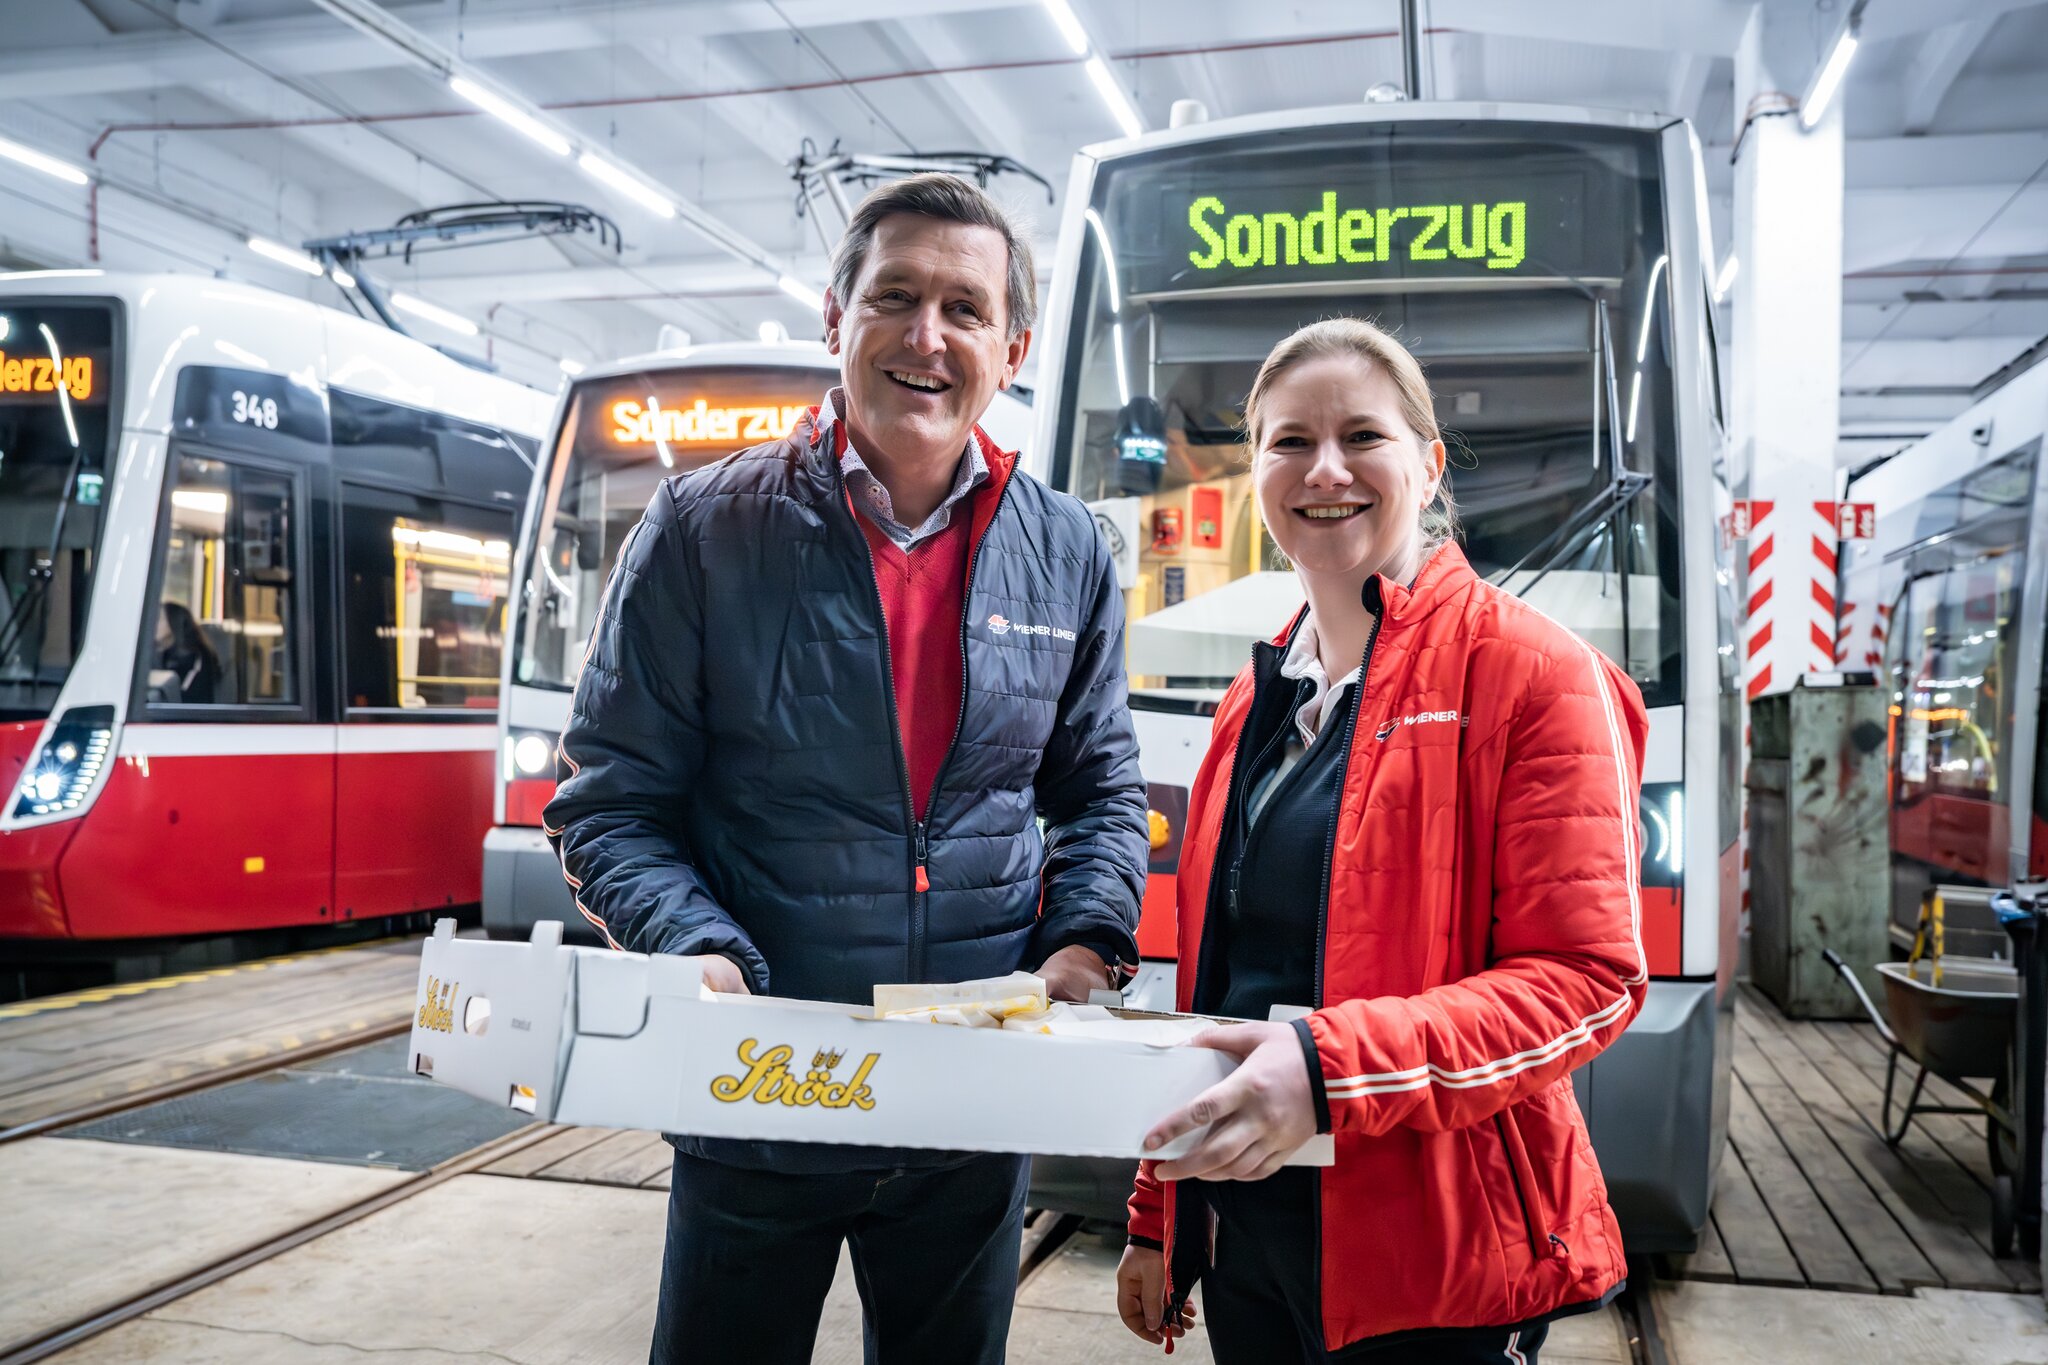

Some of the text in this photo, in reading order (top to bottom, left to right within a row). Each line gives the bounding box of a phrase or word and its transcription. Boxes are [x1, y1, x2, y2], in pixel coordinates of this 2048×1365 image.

[1189, 191, 1526, 269] Sonderzug
[0, 350, 92, 400] erzug
[232, 390, 279, 430] 348
[1013, 623, 1051, 637] WIENER
[1403, 710, 1458, 726] WIENER
[710, 1037, 882, 1111] Ströck
